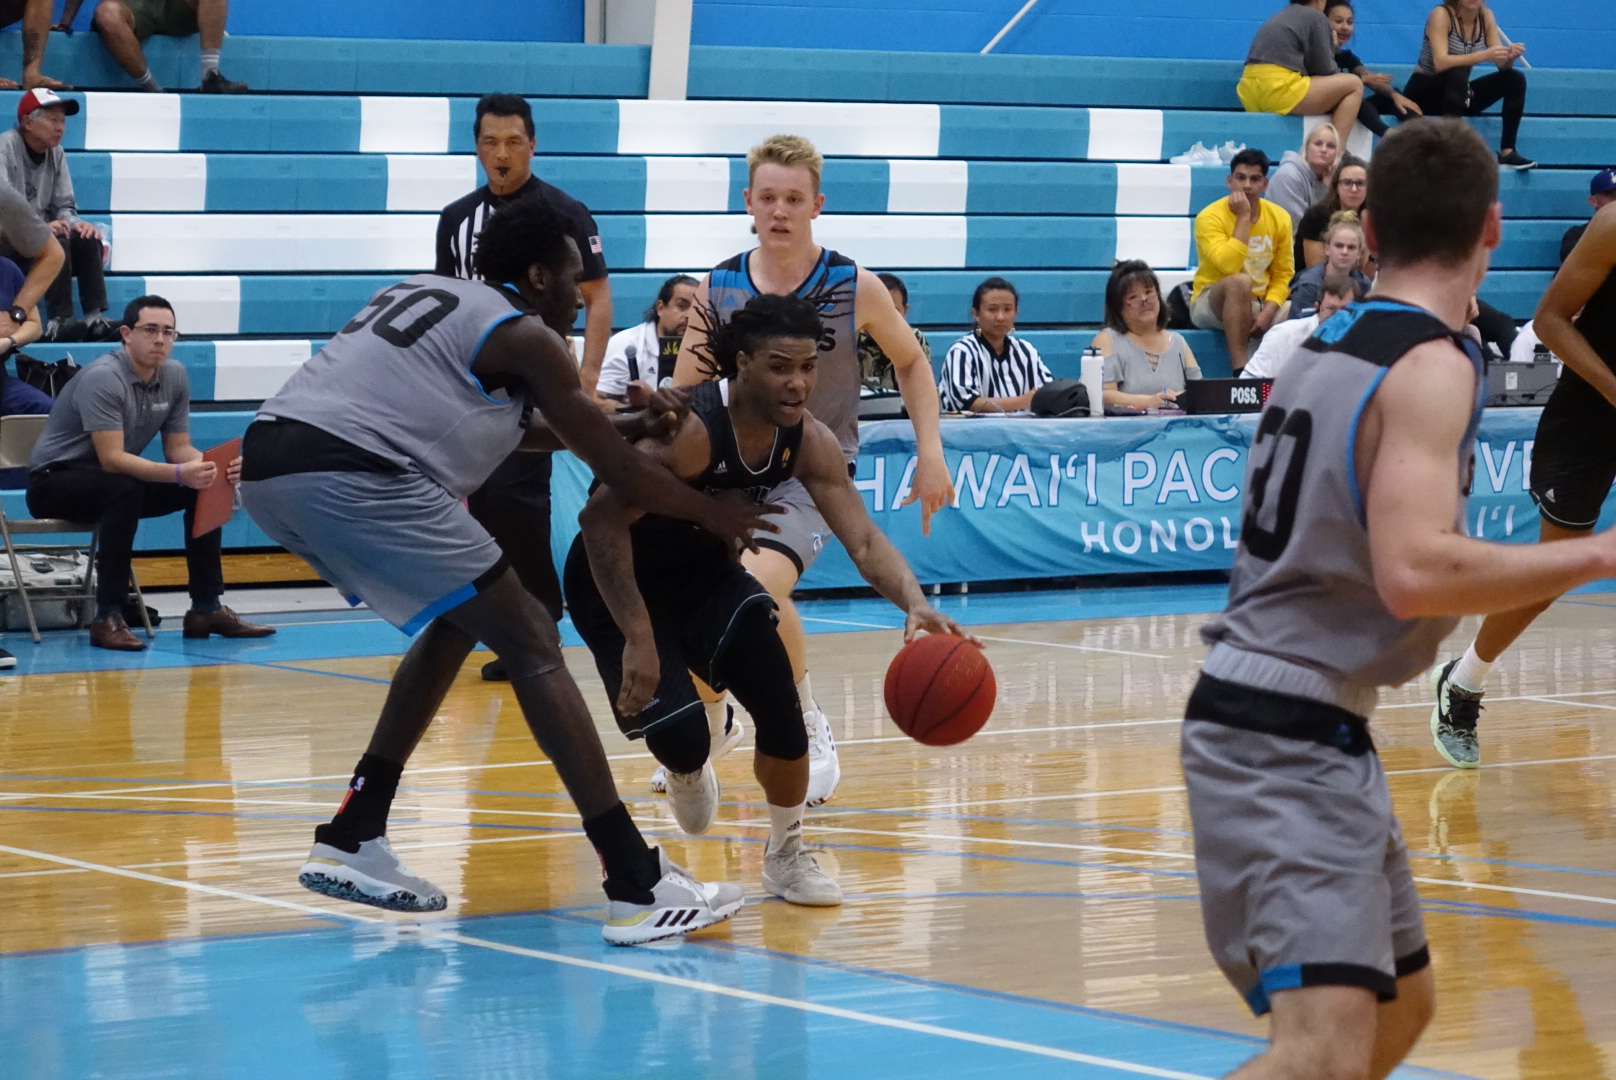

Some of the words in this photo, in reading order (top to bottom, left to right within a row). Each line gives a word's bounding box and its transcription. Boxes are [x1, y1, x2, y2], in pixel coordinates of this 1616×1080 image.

[1231, 386, 1260, 404] POSS.
[1122, 447, 1243, 506] PAC
[1081, 516, 1241, 554] HONOL
